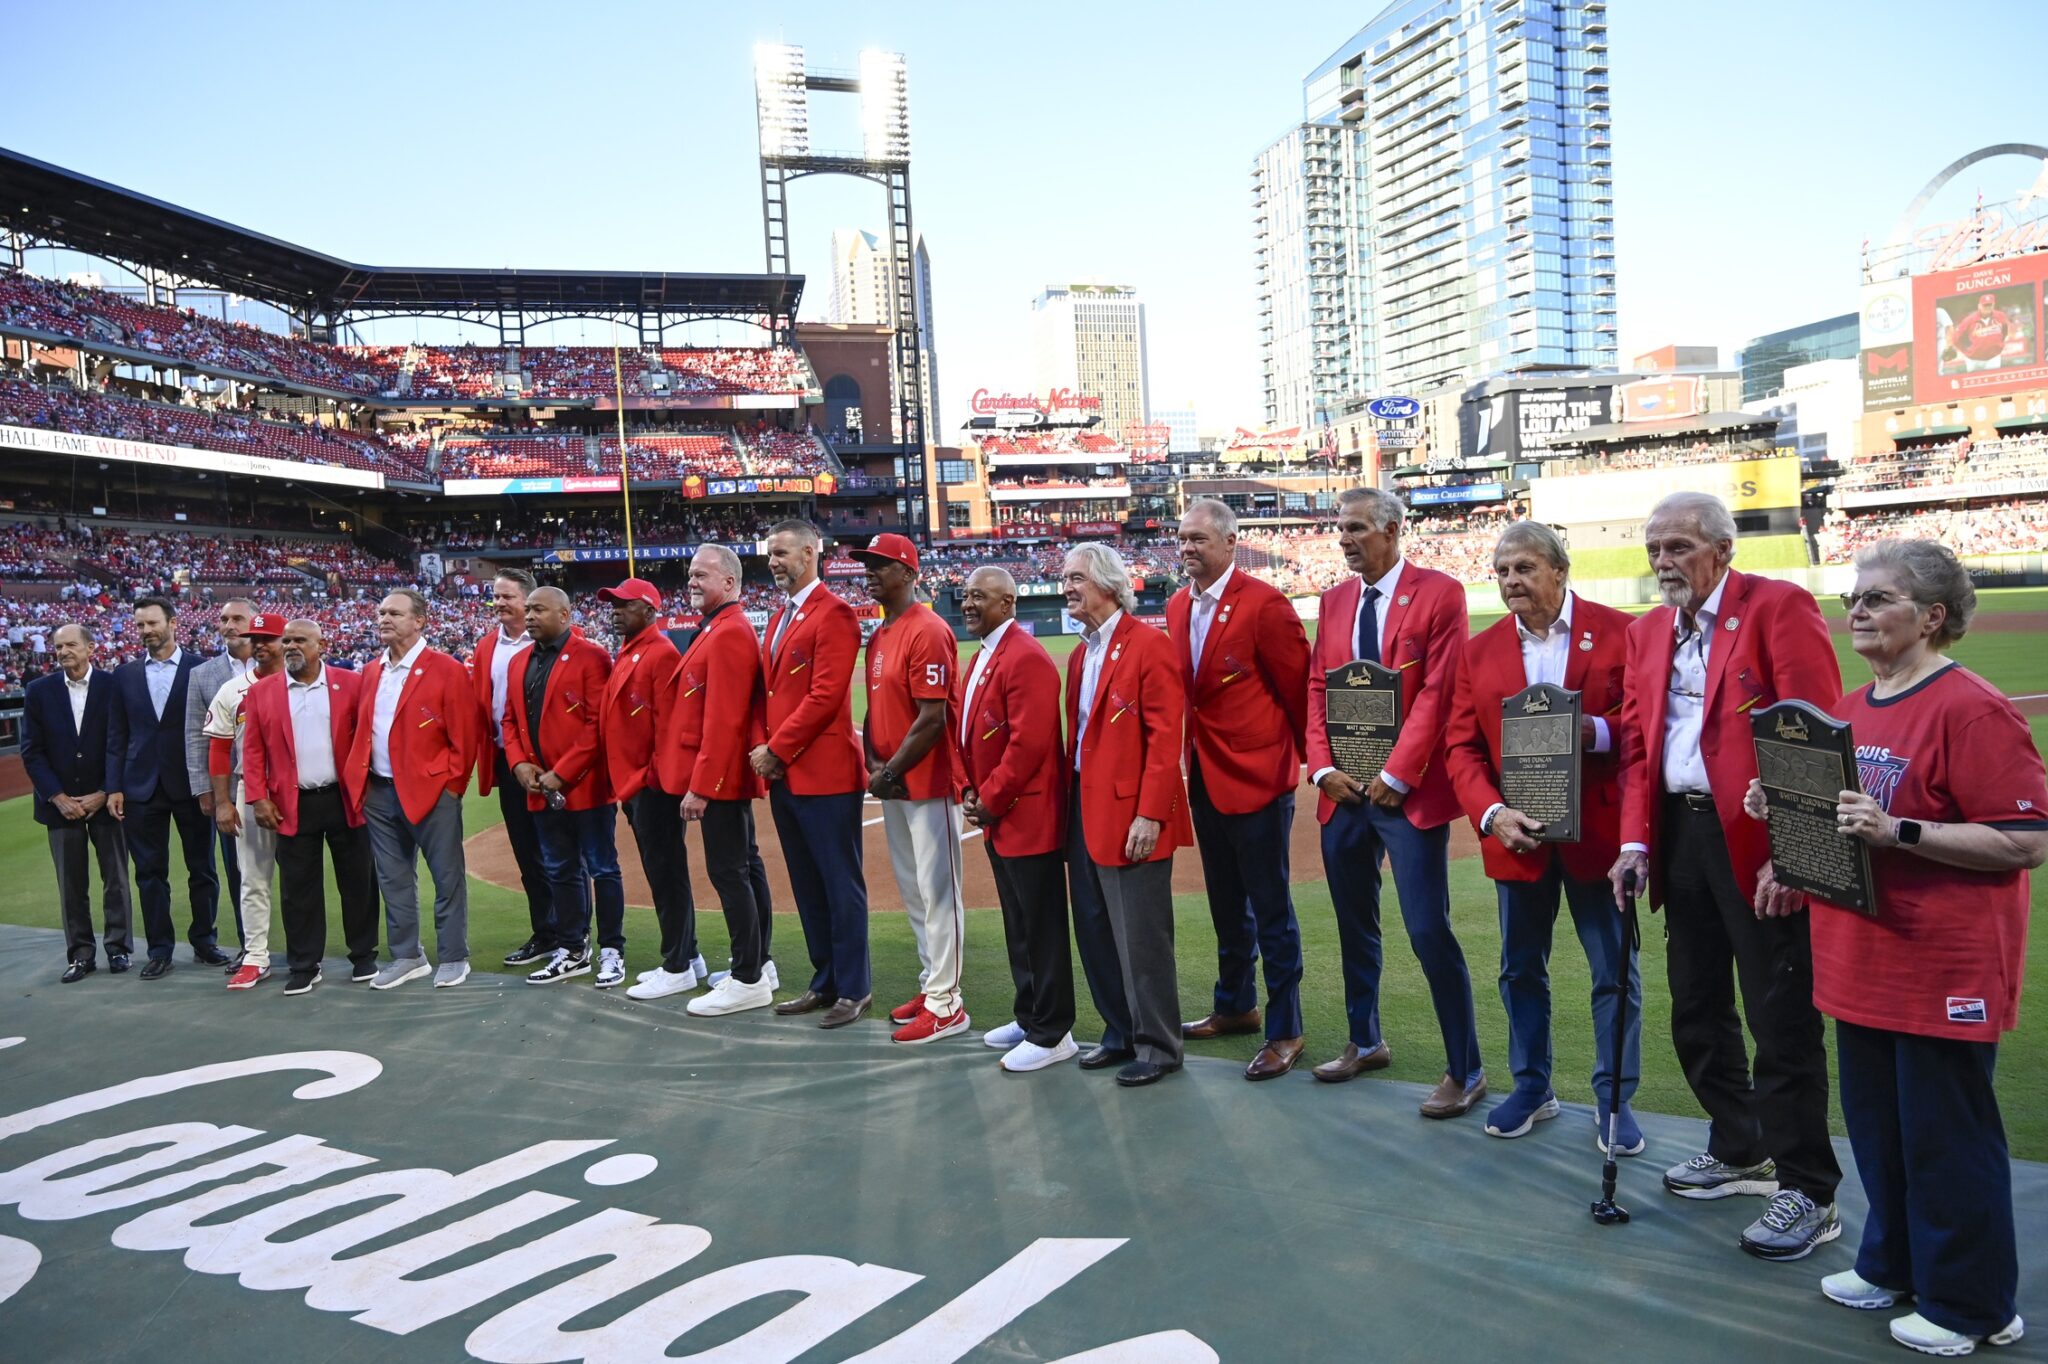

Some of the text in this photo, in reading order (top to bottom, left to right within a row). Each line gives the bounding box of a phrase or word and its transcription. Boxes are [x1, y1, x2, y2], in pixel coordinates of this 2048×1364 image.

[1956, 274, 2011, 292] DUNCAN
[971, 388, 1101, 414] Cardinals Nation
[1379, 399, 1413, 416] Ford
[1519, 401, 1601, 418] FROM THE
[1520, 417, 1590, 433] LOU AND
[1376, 429, 1424, 440] ommunity
[0, 428, 41, 448] HALL
[54, 435, 92, 453] FAME
[96, 440, 177, 462] WEEKEND
[774, 479, 813, 493] LAND
[1440, 490, 1471, 500] CREDIT
[582, 545, 751, 560] WEBSTER UNIVTY
[826, 561, 866, 569] Schnuck
[1967, 566, 2023, 577] GetsUs.com
[926, 664, 945, 686] 51
[1532, 756, 1552, 764] DUNCAN
[1855, 745, 1890, 762] OUIS
[0, 1050, 1222, 1364] ardinal
